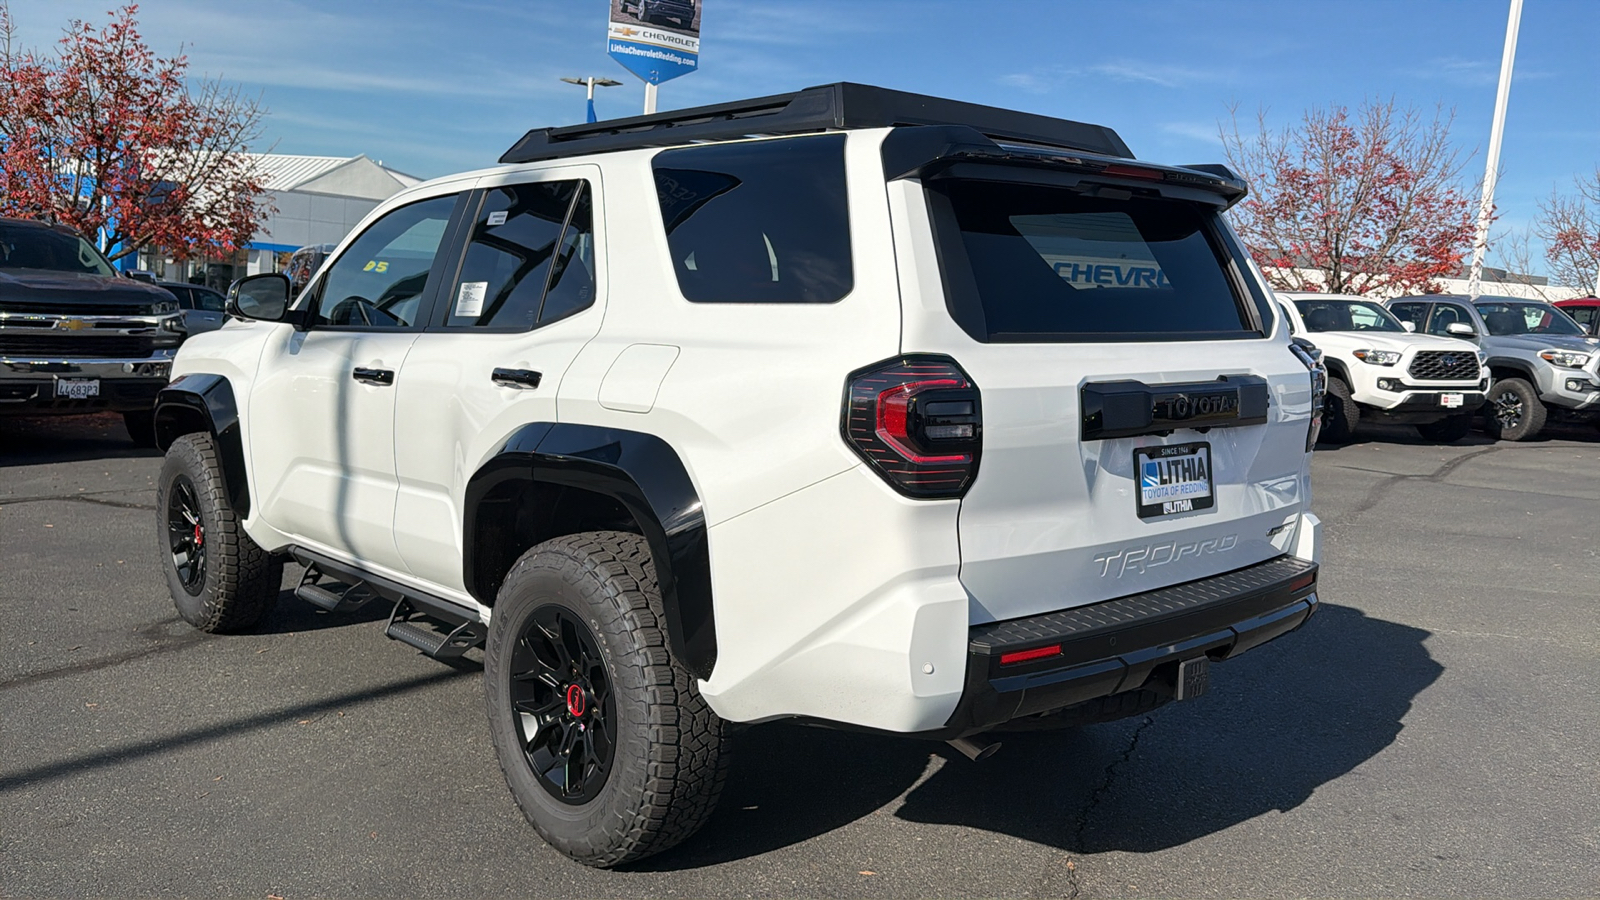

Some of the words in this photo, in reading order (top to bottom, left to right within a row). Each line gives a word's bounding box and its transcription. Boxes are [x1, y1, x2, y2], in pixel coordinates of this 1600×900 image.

[642, 31, 696, 48] CHEVROLET
[610, 43, 696, 66] LithiaChevroletRedding.com
[1165, 396, 1230, 419] TOYOTA
[1161, 447, 1178, 456] SINCE
[1157, 456, 1207, 485] LITHIA
[1143, 487, 1169, 499] TOYOTA
[1170, 485, 1179, 496] OF
[1180, 481, 1208, 494] REDDING
[1170, 499, 1193, 513] LITHIA
